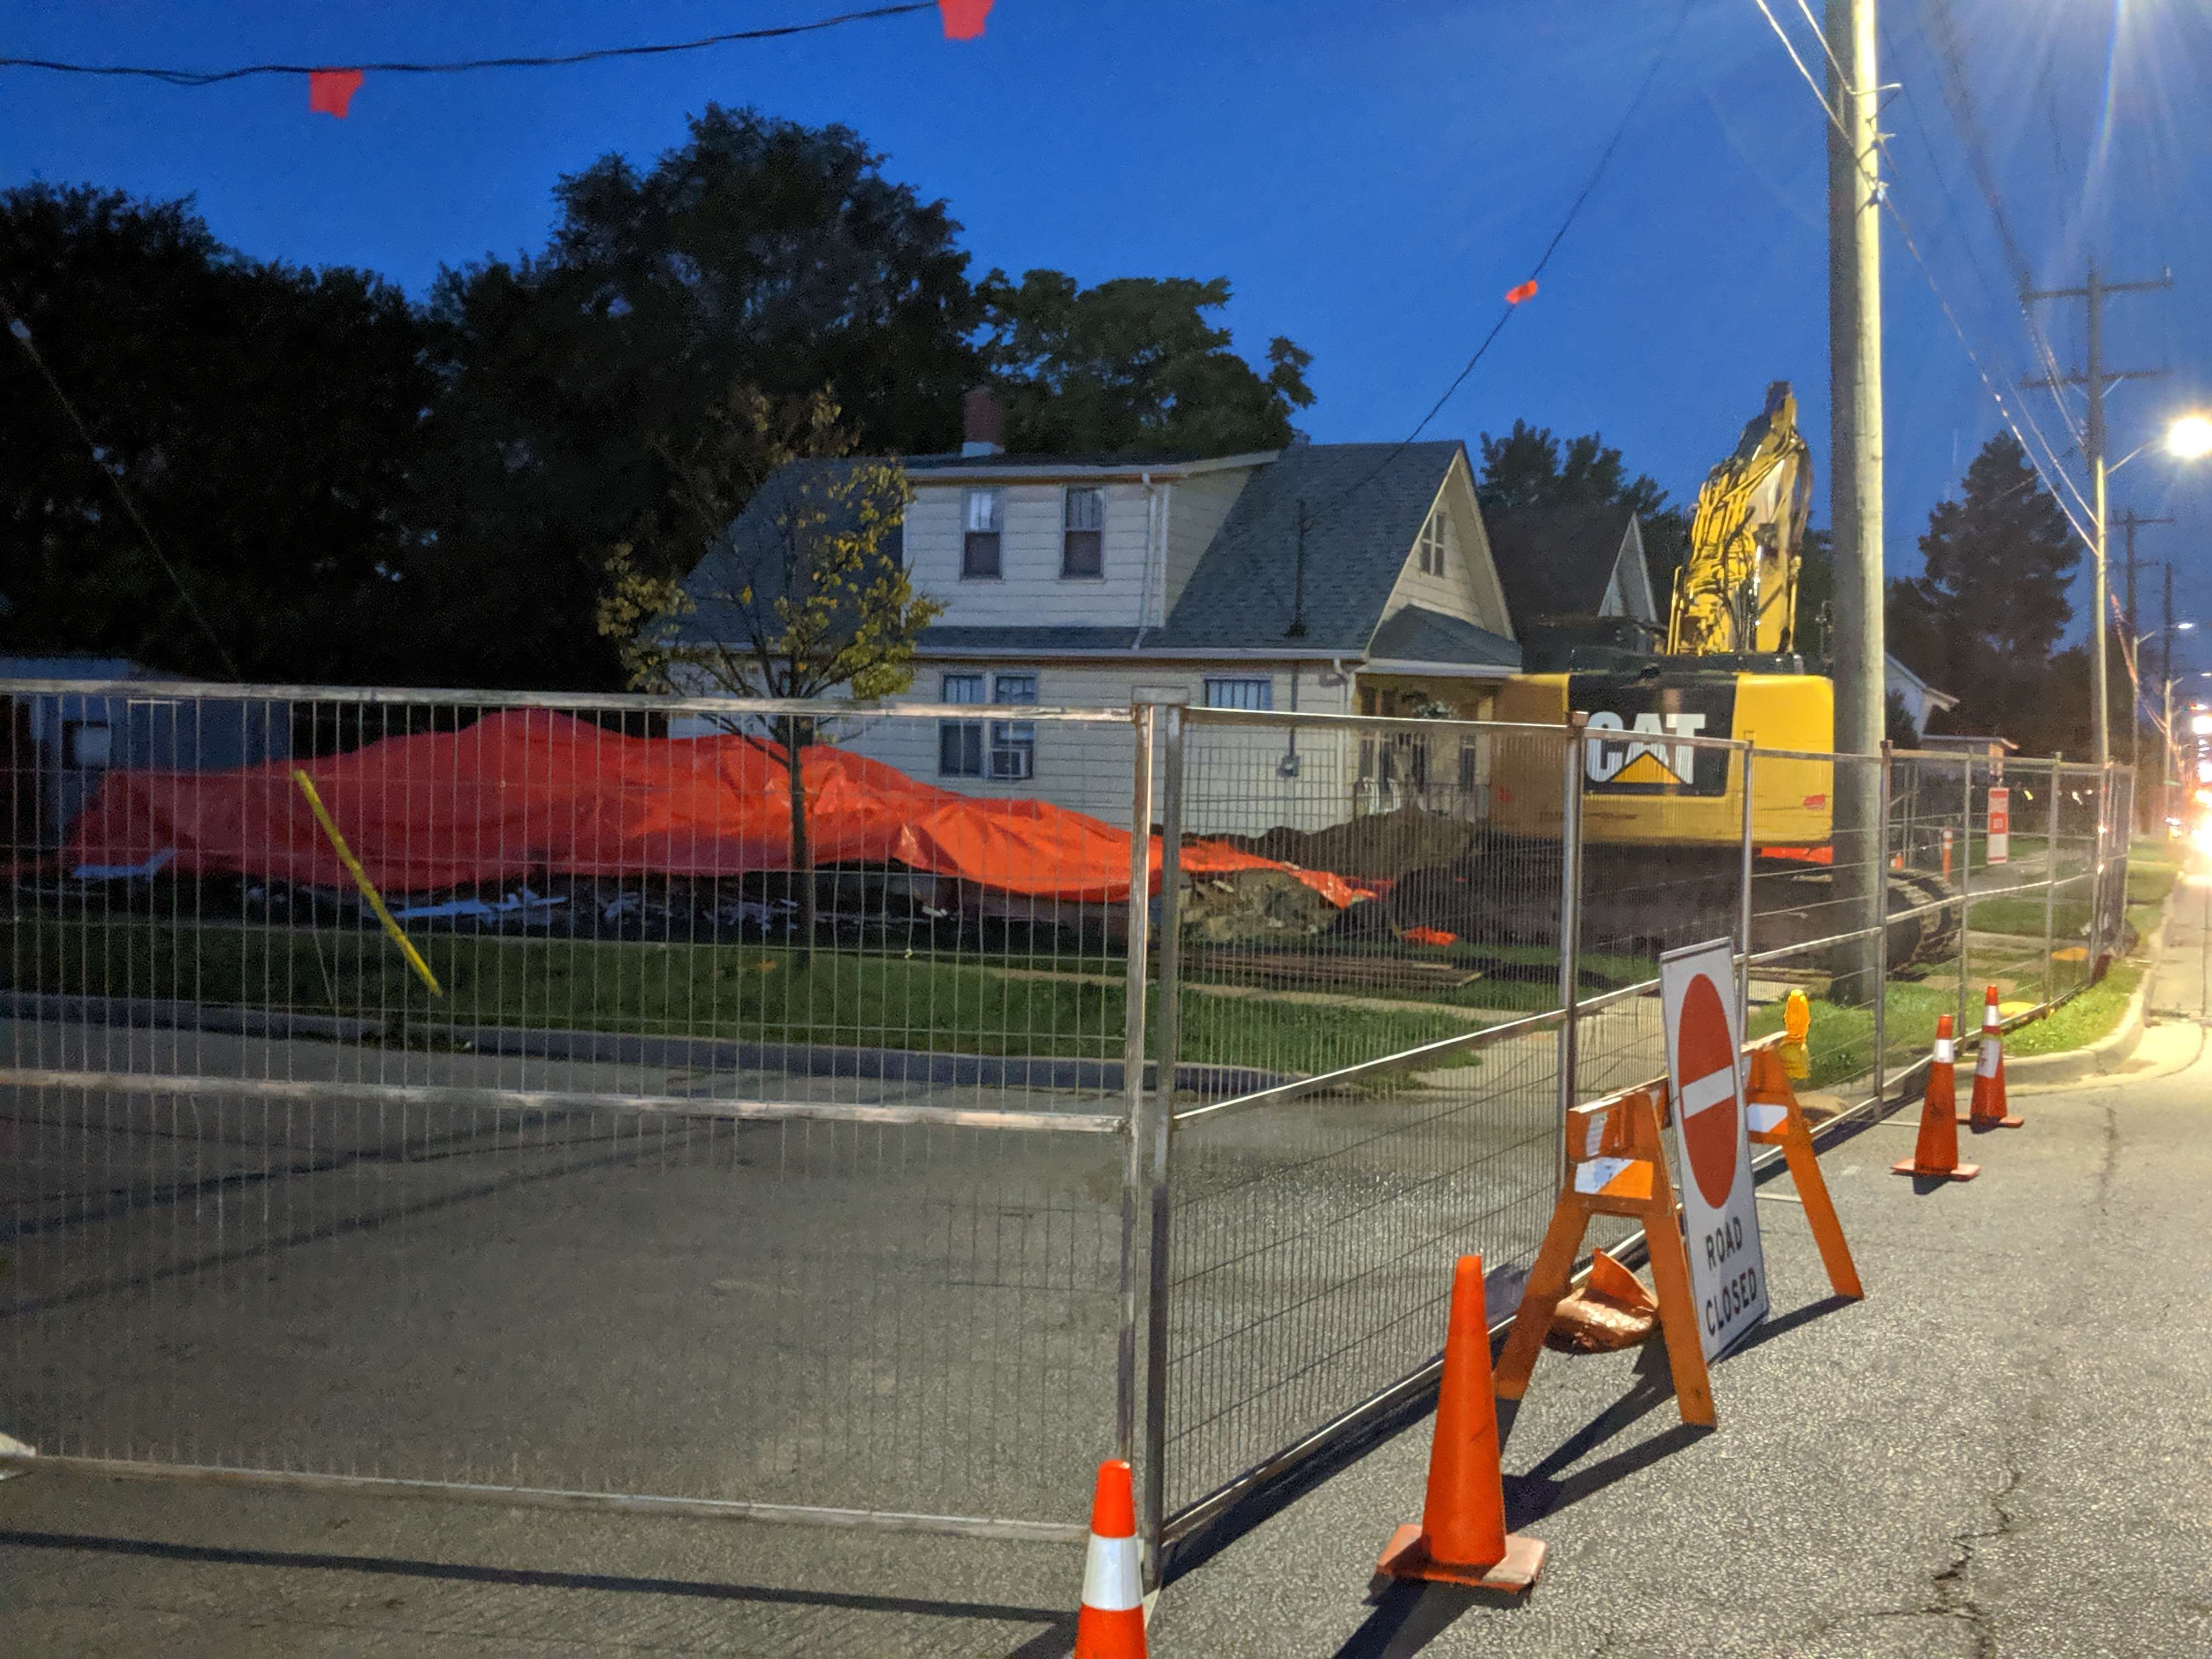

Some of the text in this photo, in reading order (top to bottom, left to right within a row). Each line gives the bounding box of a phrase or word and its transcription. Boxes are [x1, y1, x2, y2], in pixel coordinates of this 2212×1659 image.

[1586, 711, 1706, 785] CAT
[1706, 1216, 1742, 1271] ROAD
[1706, 1267, 1757, 1336] CLOSED
